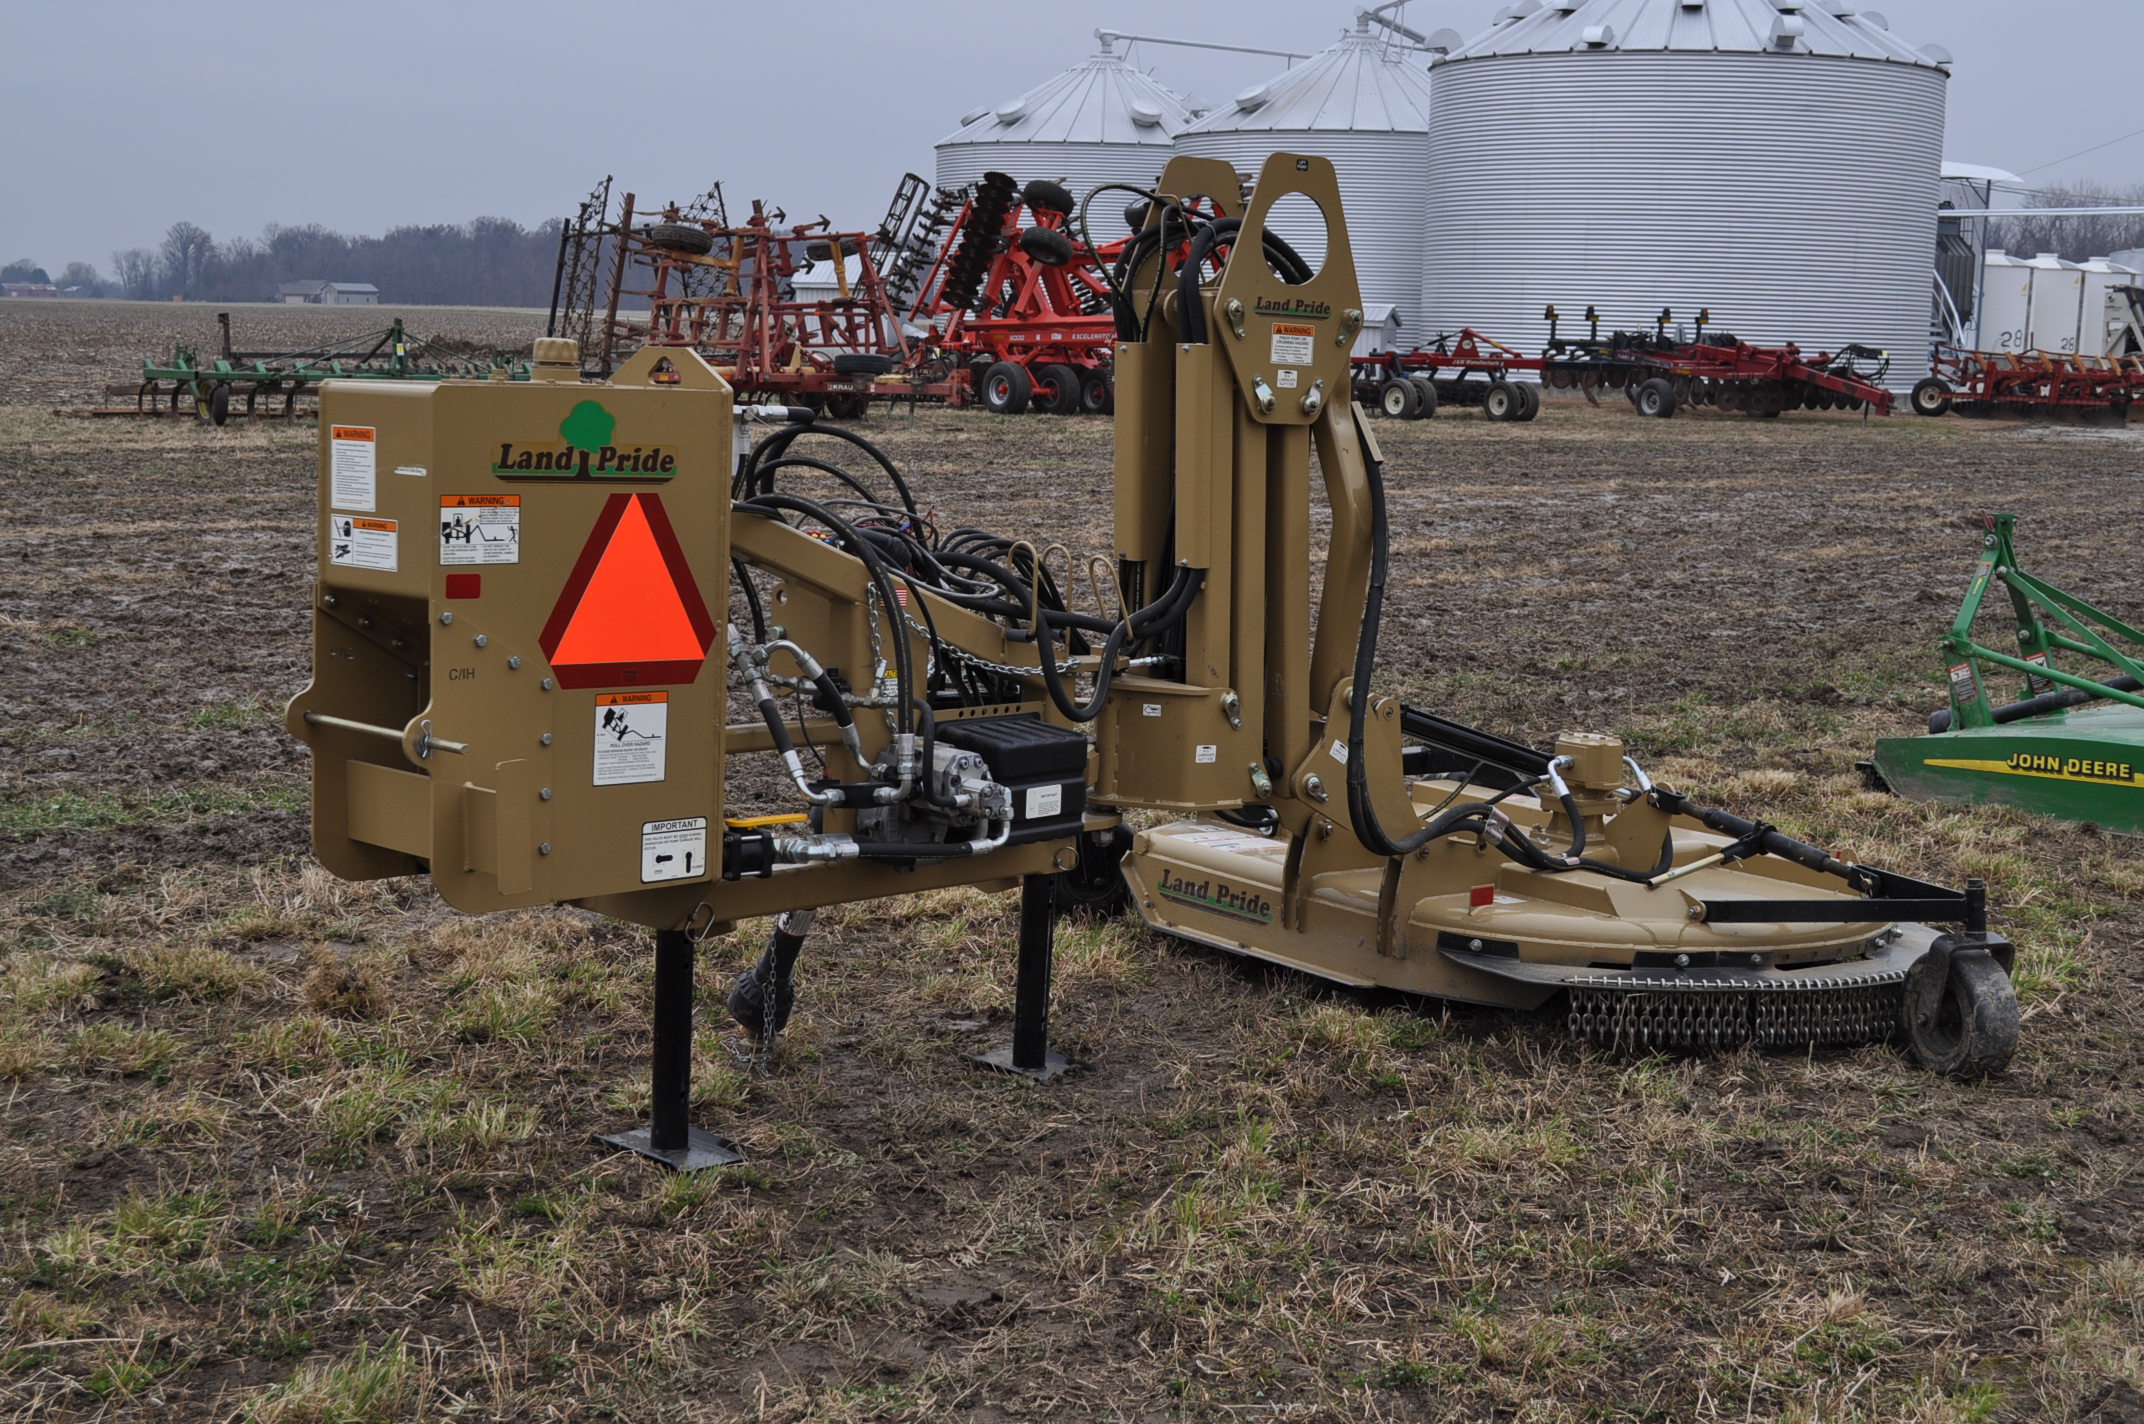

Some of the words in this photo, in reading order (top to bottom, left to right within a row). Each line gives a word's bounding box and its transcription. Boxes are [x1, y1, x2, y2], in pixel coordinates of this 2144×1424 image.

[1256, 296, 1290, 311] Land
[1295, 300, 1331, 314] Pride
[1283, 327, 1311, 335] WARNING
[2000, 329, 2023, 348] 28
[2060, 337, 2075, 352] 28
[497, 443, 575, 471] Land
[596, 446, 675, 473] Pride
[468, 497, 504, 505] WARNING
[449, 667, 476, 681] C/IH
[622, 694, 652, 702] WARNING
[2007, 752, 2060, 771] JOHN
[2067, 758, 2131, 778] DEERE
[651, 820, 698, 832] IMPORTANT
[1161, 869, 1210, 900] Land
[1215, 884, 1271, 917] Pride
